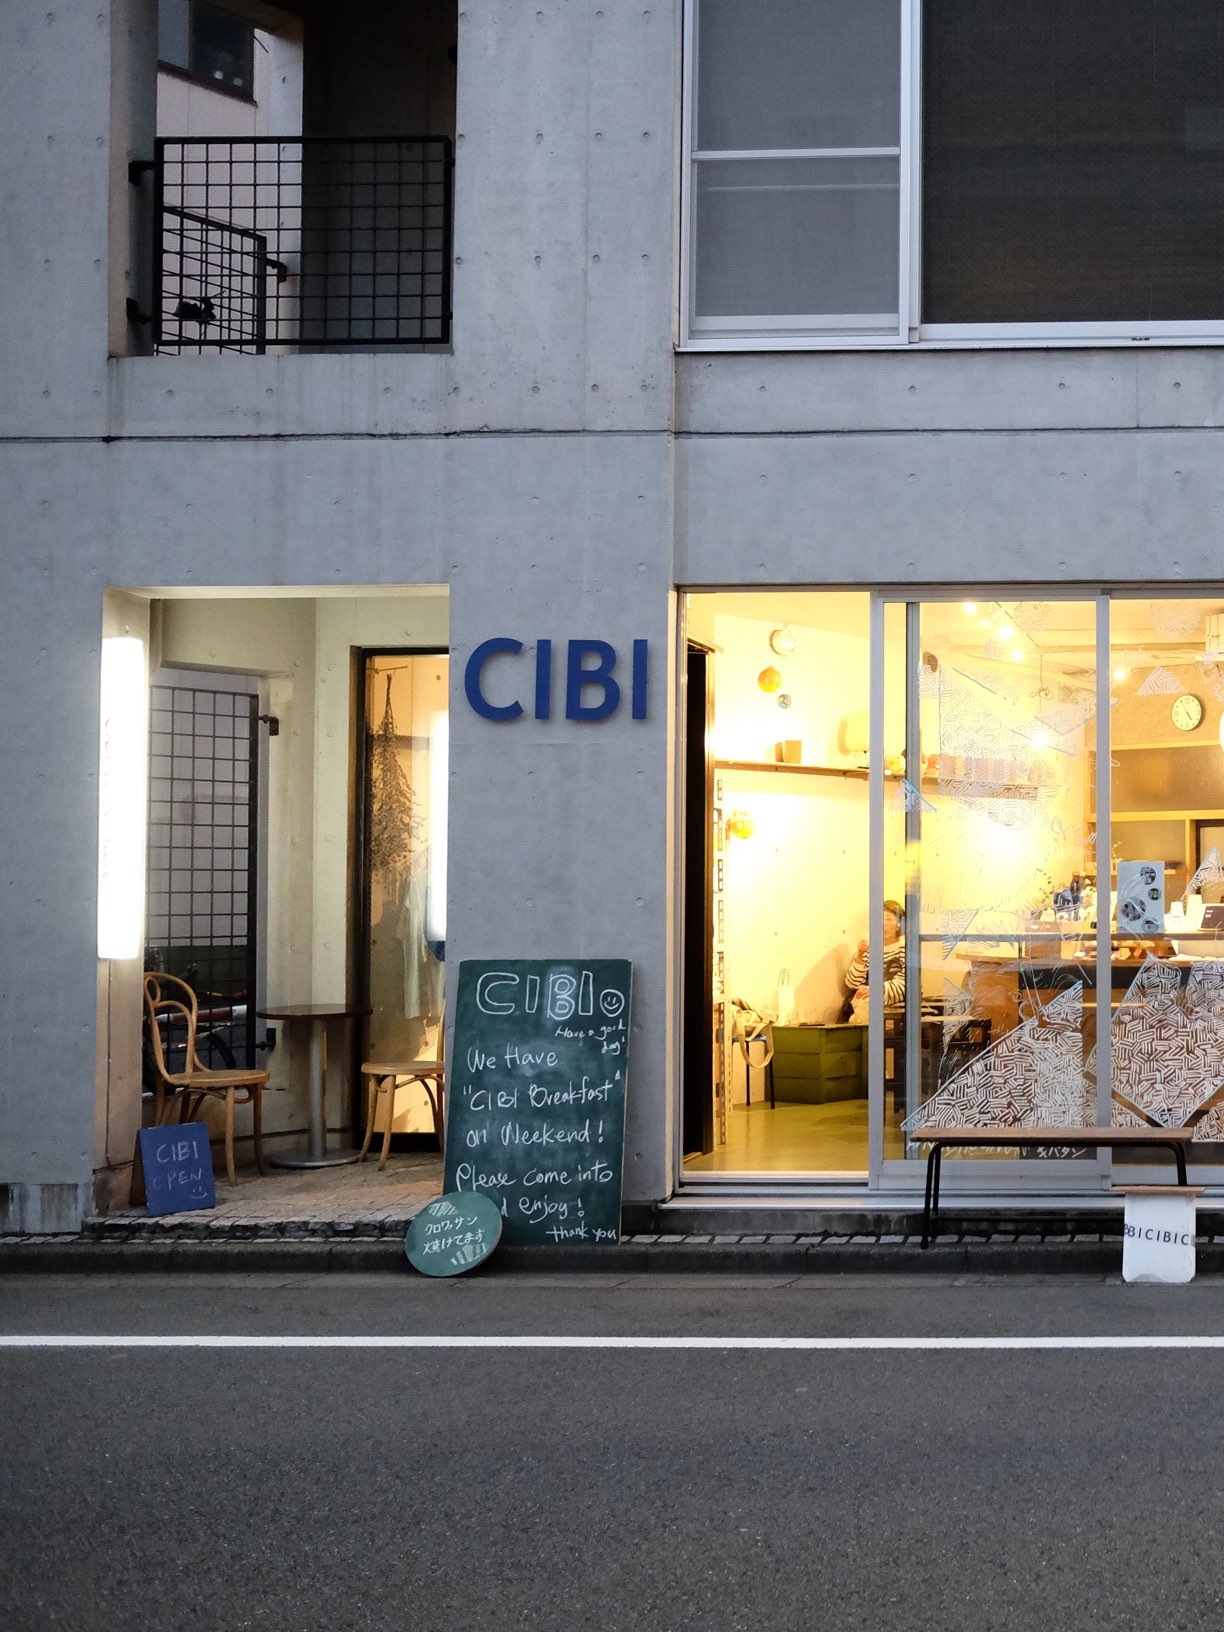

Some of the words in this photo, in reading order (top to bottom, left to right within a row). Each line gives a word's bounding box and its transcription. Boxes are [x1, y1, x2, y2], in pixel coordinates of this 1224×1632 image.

[464, 637, 648, 721] CIBI
[476, 971, 593, 1020] CIBI
[555, 1025, 586, 1038] Have
[467, 1047, 497, 1072] We
[504, 1042, 558, 1068] Have
[466, 1129, 488, 1147] on
[156, 1141, 199, 1163] CIBI
[455, 1160, 517, 1192] Please
[523, 1168, 571, 1187] come
[578, 1160, 613, 1183] into
[423, 1228, 486, 1255] 焼けてます
[592, 1227, 617, 1243] you
